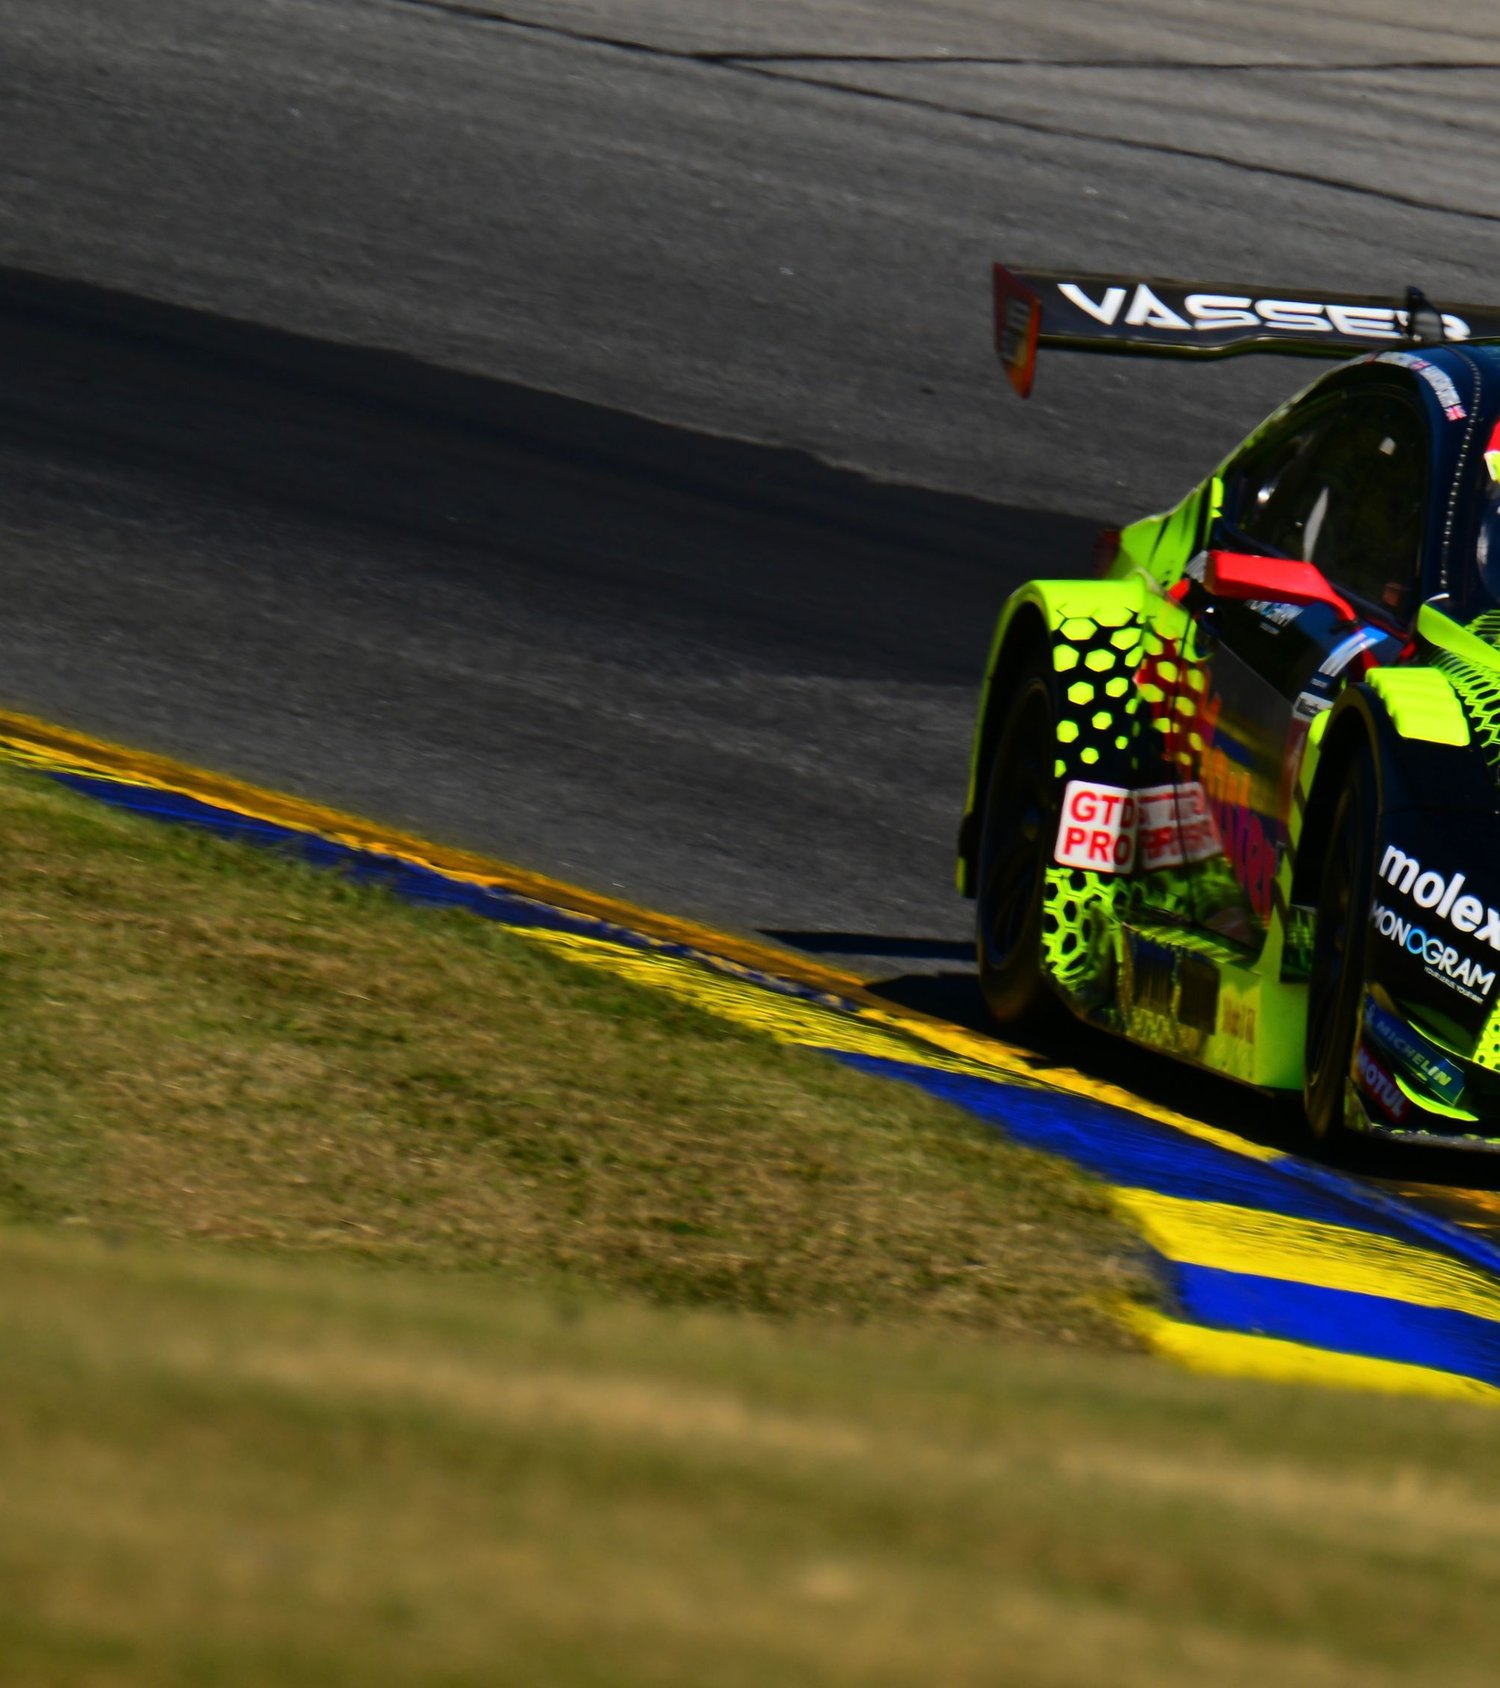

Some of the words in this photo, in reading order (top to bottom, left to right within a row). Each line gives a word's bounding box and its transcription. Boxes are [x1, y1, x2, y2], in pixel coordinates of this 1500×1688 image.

[1070, 790, 1137, 830] GTD
[1063, 826, 1132, 867] PRO
[1369, 900, 1496, 995] MONOGRAM
[1357, 1046, 1406, 1118] MOTUL
[1375, 1020, 1453, 1087] MICHELIN
